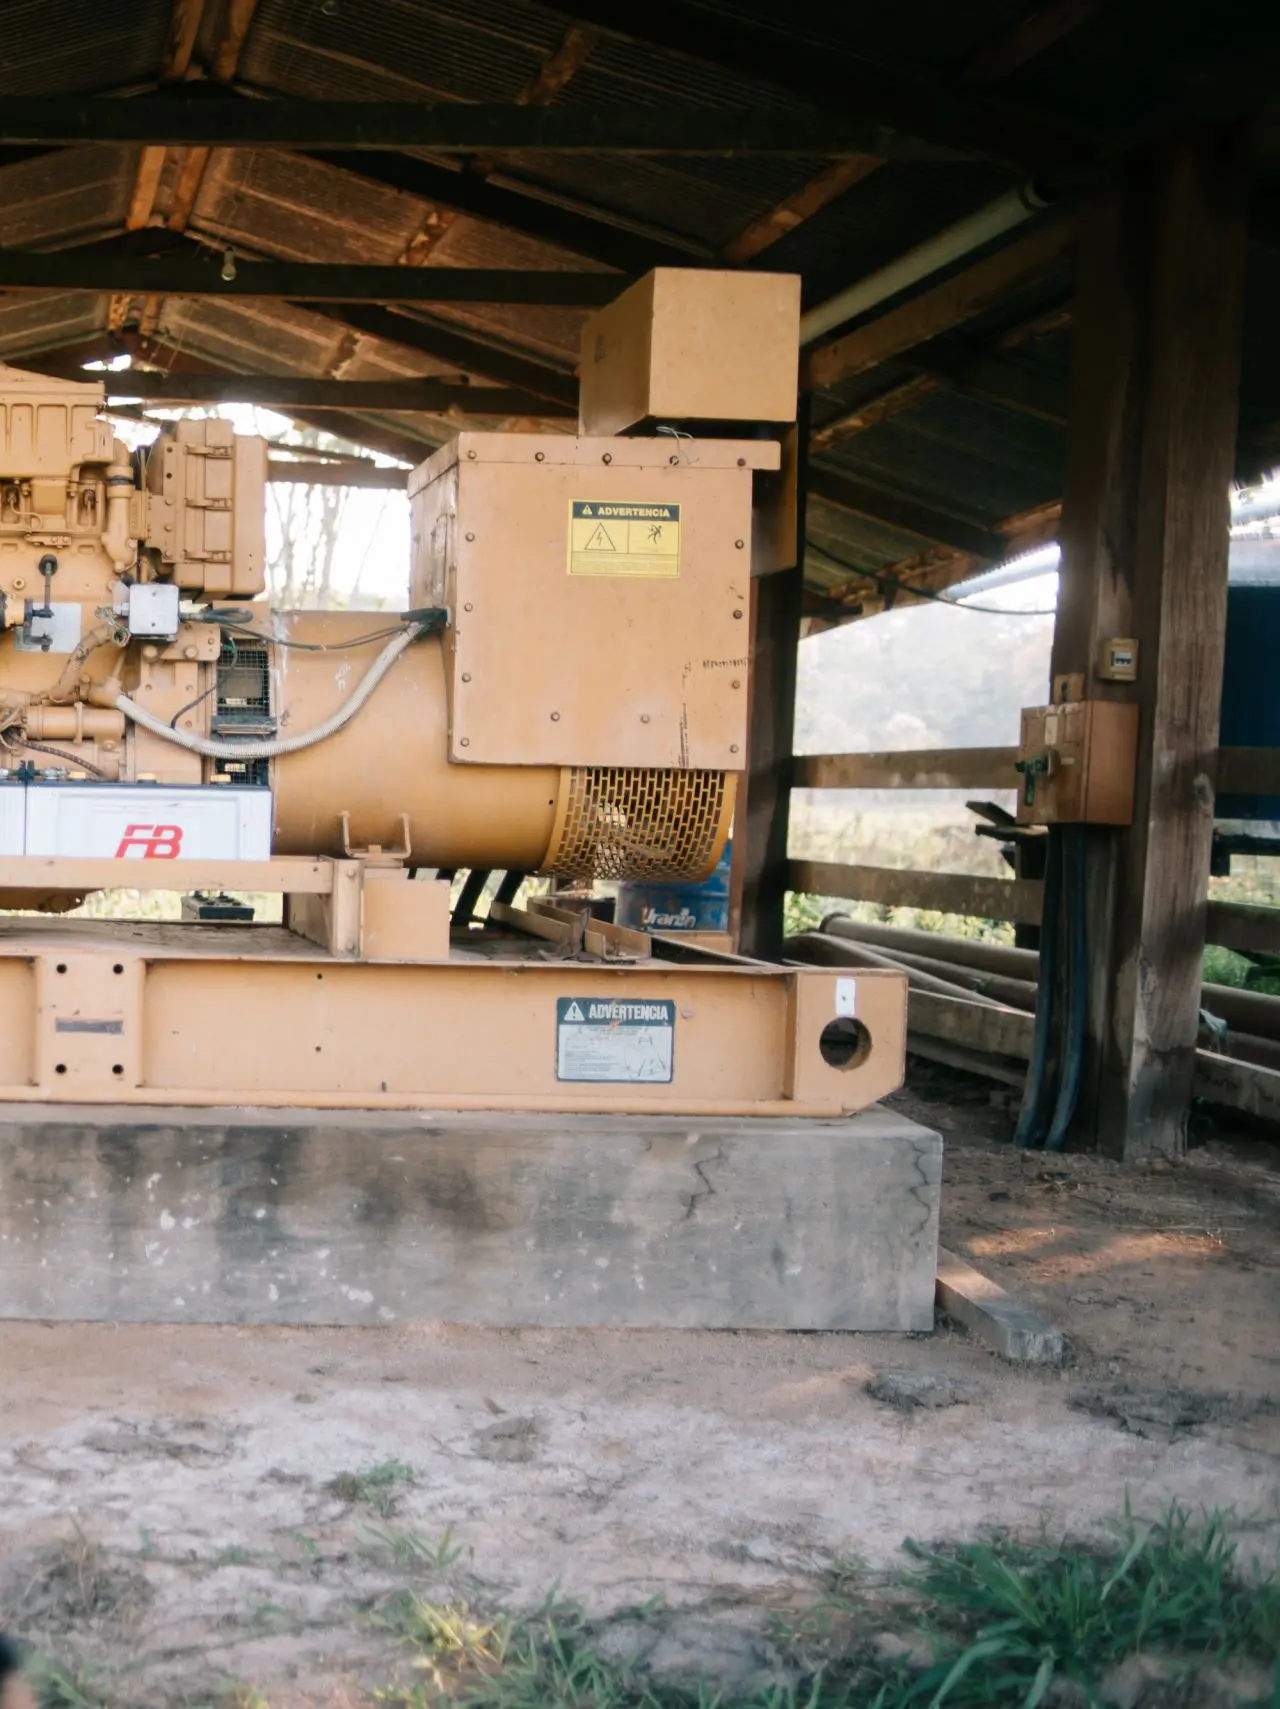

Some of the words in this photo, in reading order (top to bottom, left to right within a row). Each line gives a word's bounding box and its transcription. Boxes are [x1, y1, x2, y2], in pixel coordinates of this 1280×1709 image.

[597, 506, 671, 518] ADVERTENCIA
[115, 824, 183, 859] FB
[588, 1003, 669, 1020] ADVERTENCIA
